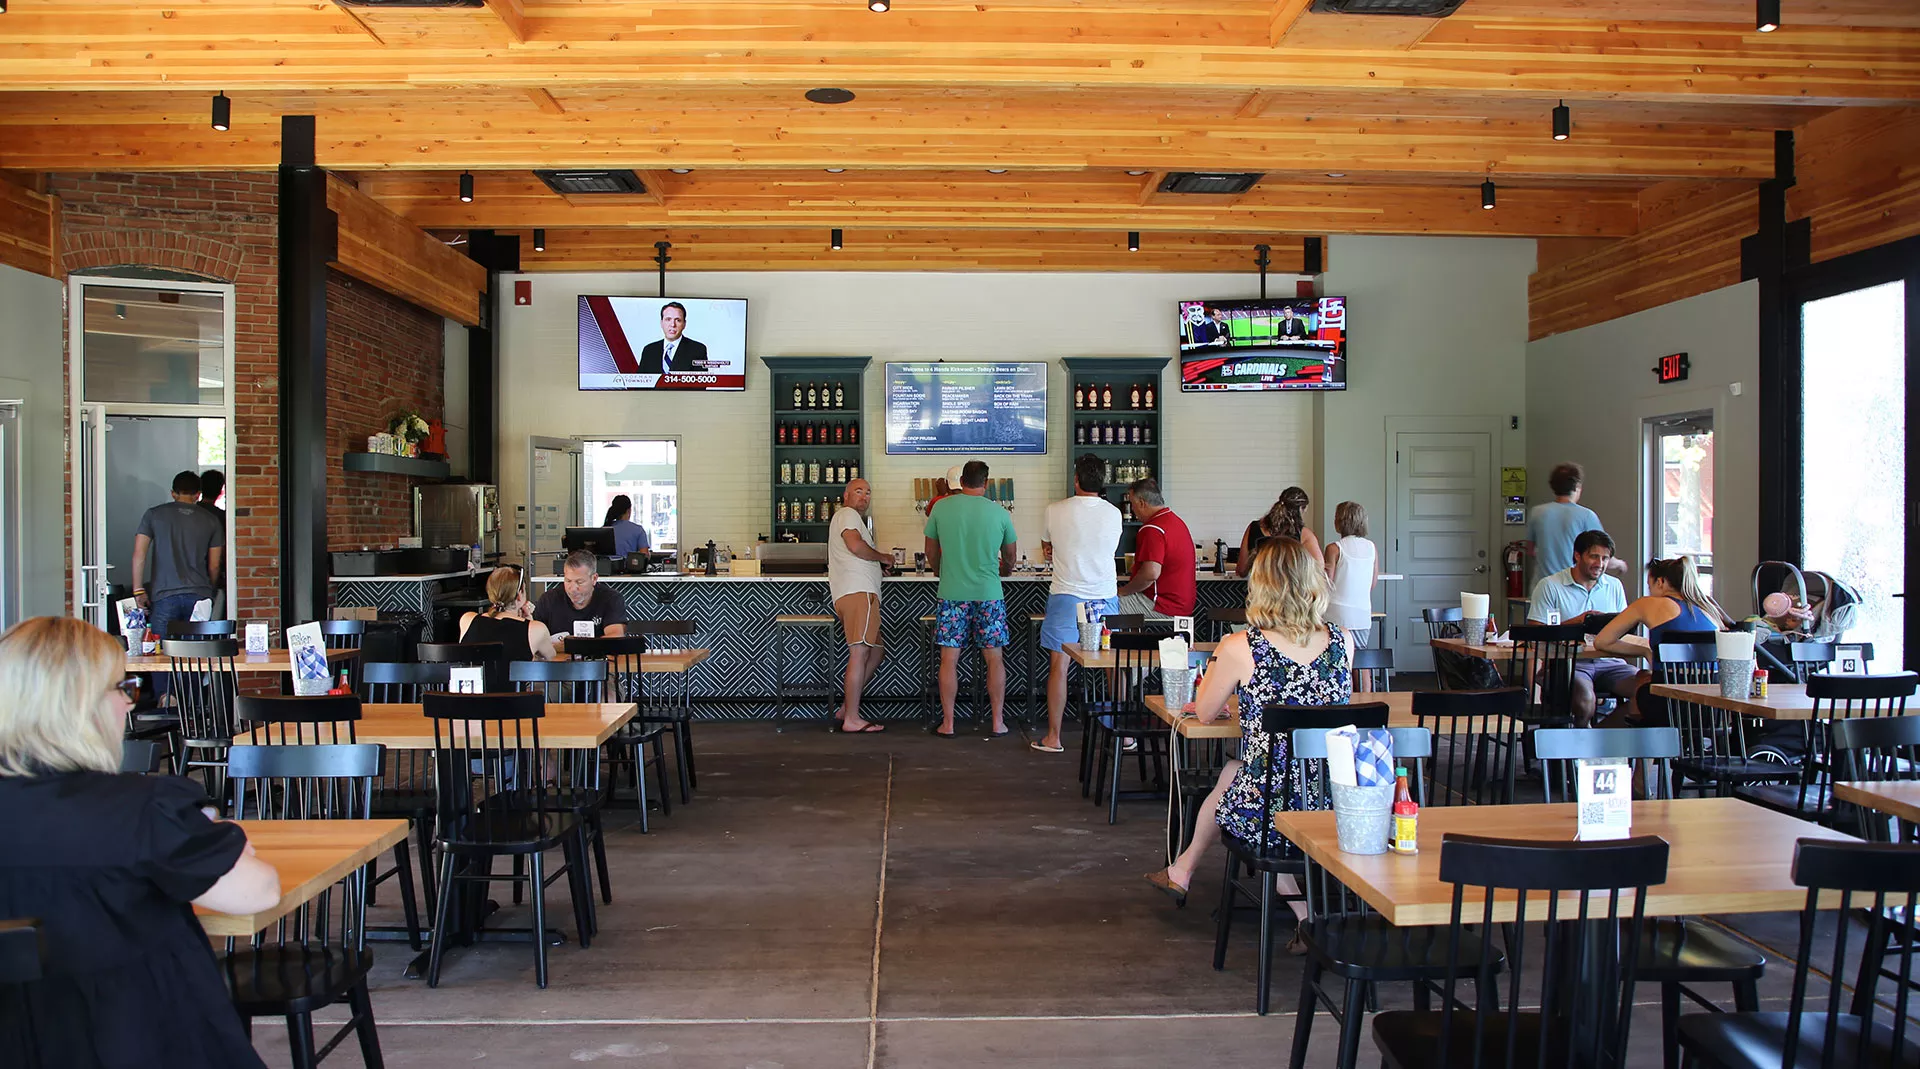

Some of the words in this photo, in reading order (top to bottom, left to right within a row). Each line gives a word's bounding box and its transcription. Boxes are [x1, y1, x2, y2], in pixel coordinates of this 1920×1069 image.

[1233, 363, 1287, 376] CARDINALS
[1663, 354, 1680, 380] EXIT
[663, 375, 718, 384] 314-500-5000
[1179, 620, 1188, 628] 40
[1844, 660, 1854, 671] 43
[1596, 772, 1615, 791] 44
